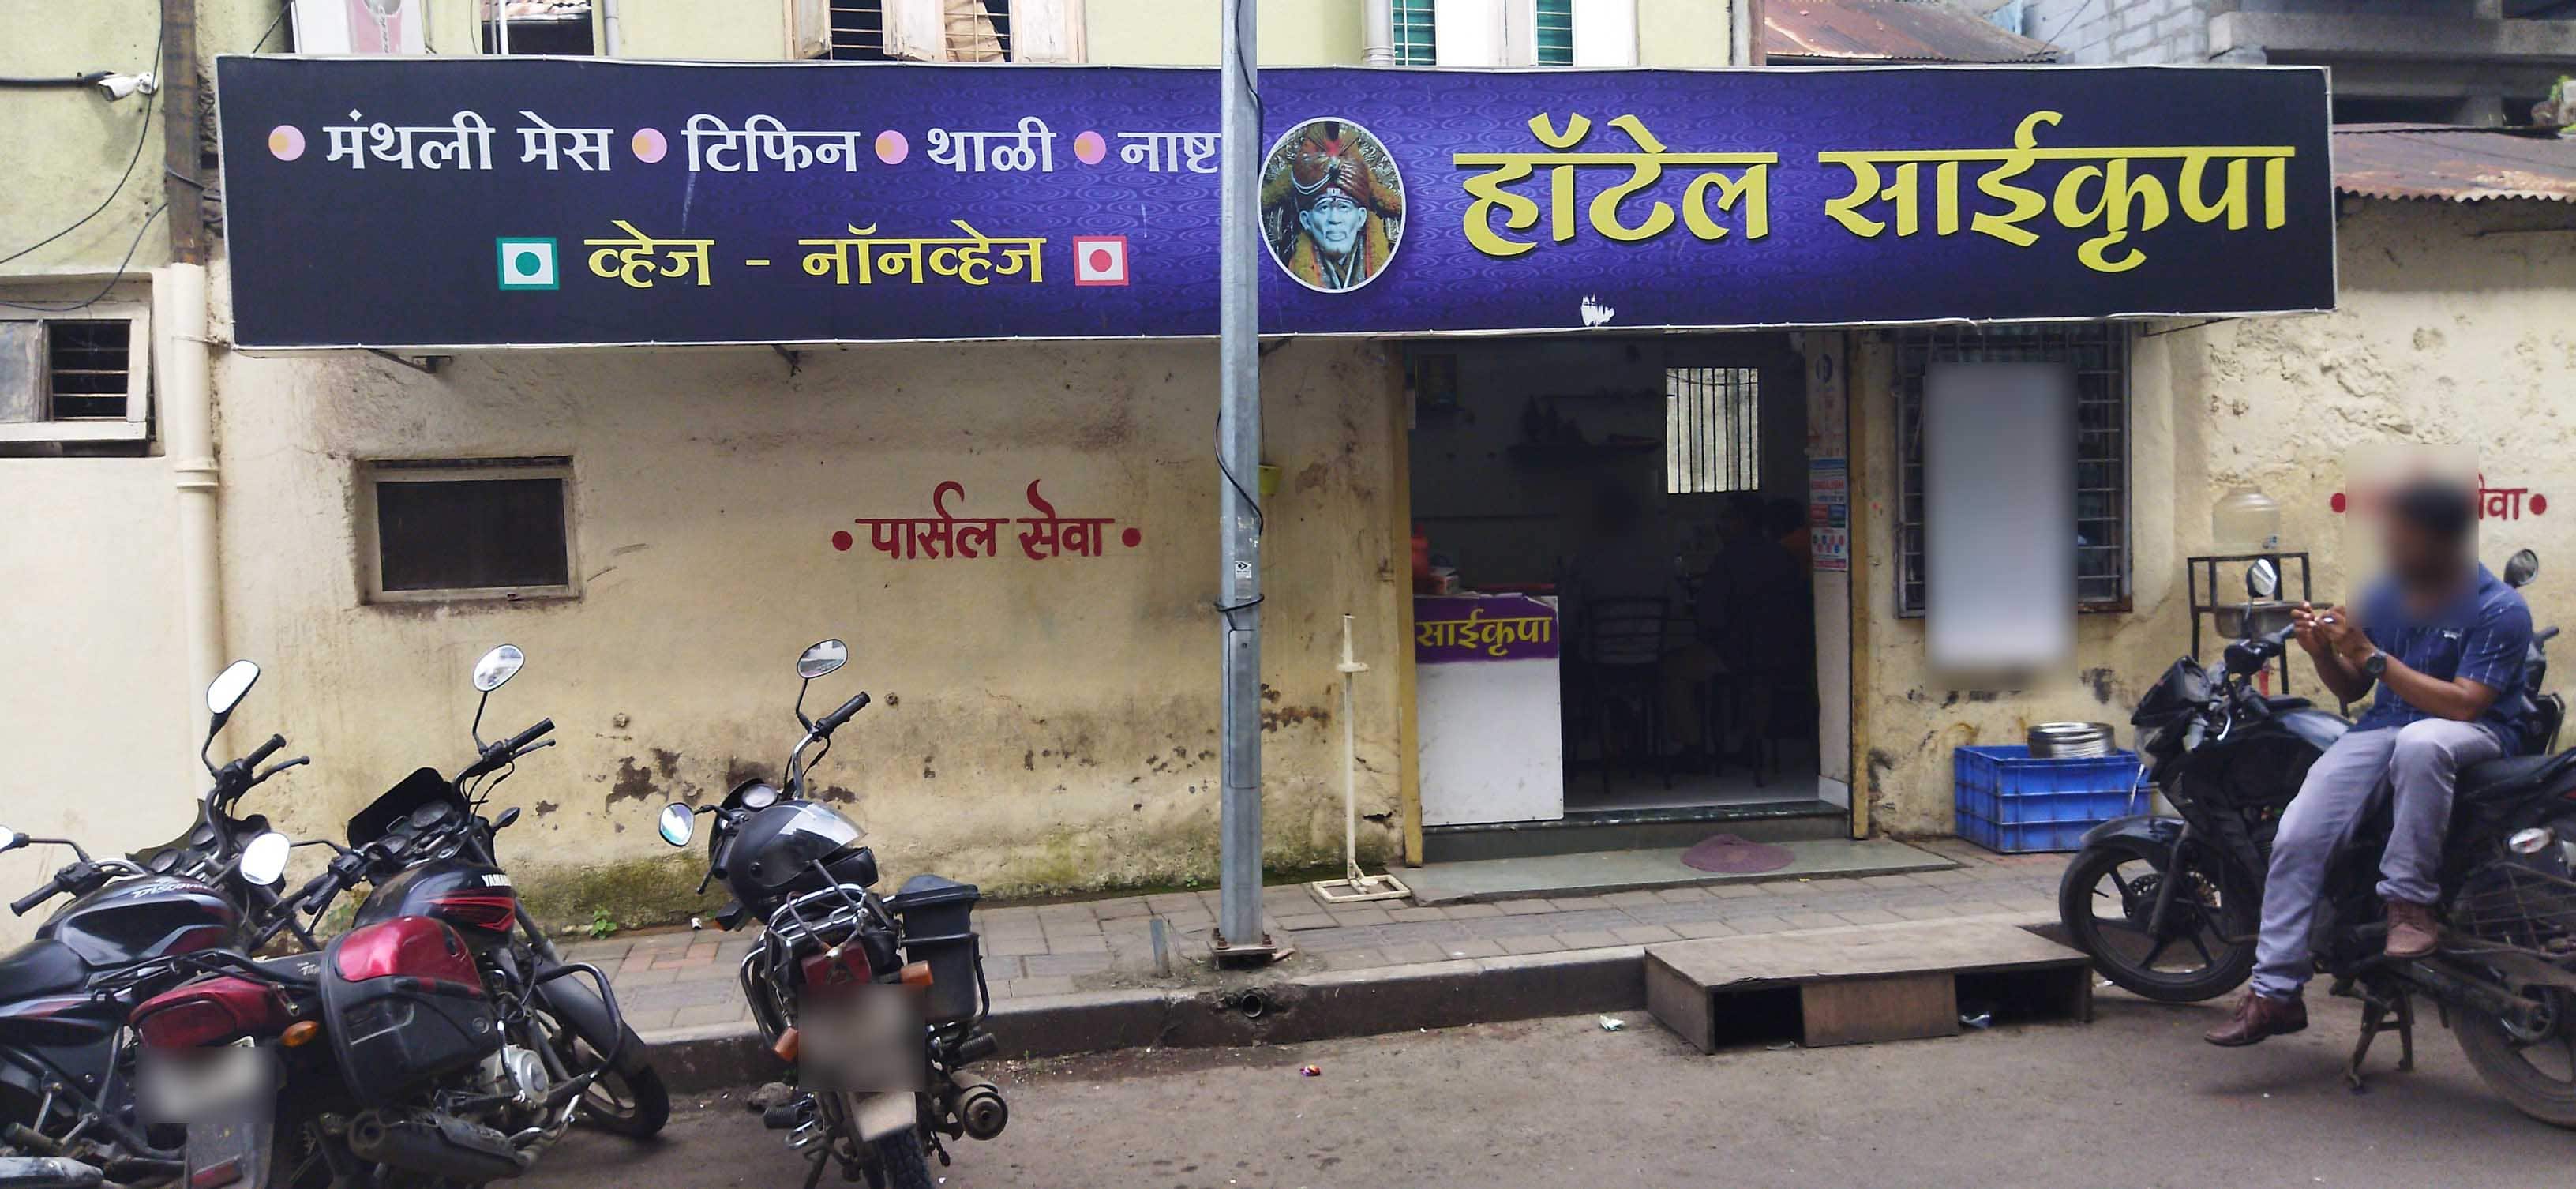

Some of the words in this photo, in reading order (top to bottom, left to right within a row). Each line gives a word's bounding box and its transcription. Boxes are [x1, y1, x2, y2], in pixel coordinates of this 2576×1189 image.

[322, 108, 496, 170] मंथली
[516, 111, 614, 171] मेस
[680, 114, 861, 172] टिफिन
[927, 116, 1057, 172] थाळी
[1117, 132, 1221, 174] नाष्ट
[1453, 113, 1778, 256] हॉटेल
[1818, 111, 2296, 272] साईकृपा
[584, 220, 714, 288] व्हेज
[799, 219, 1047, 286] नॉनव्हेज
[855, 481, 1010, 559] पार्सल
[1016, 479, 1115, 560] सेवा
[1415, 608, 1553, 655] साईकृपा
